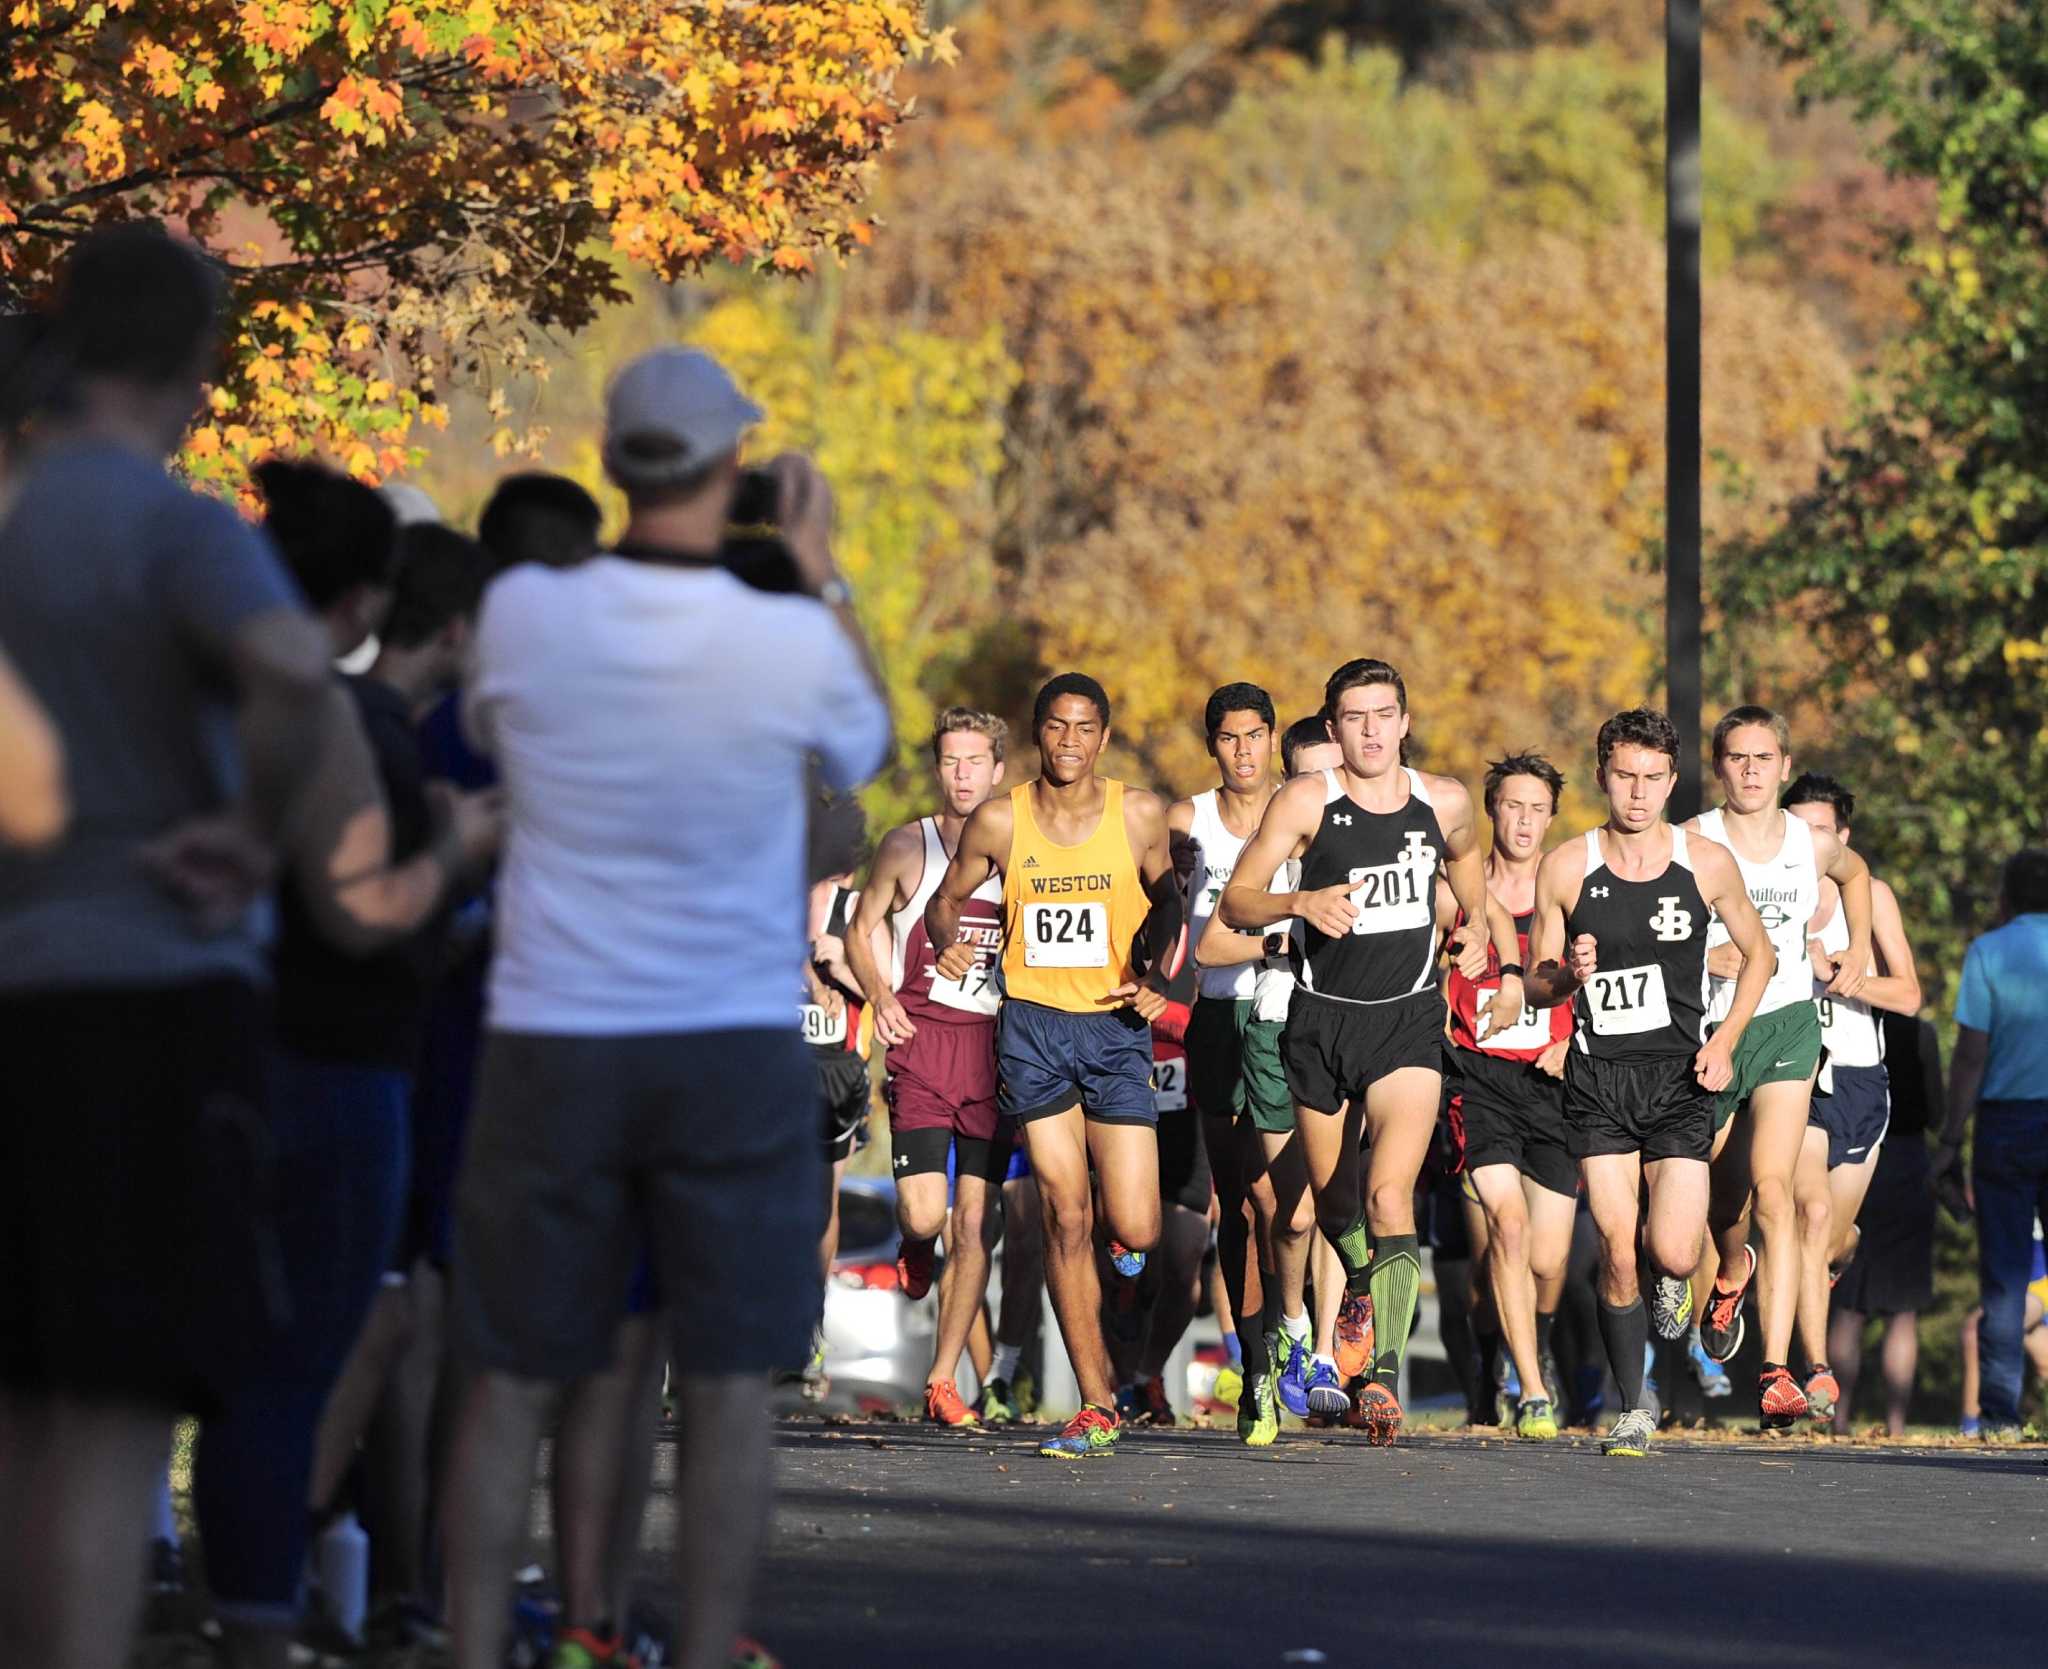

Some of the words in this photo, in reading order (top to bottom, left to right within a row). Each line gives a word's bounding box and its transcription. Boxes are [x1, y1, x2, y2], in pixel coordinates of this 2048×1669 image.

[1031, 873, 1112, 895] WESTON
[1363, 868, 1420, 908] 201
[1749, 887, 1799, 903] Milford
[1036, 908, 1095, 943] 624
[1595, 972, 1649, 1011] 217
